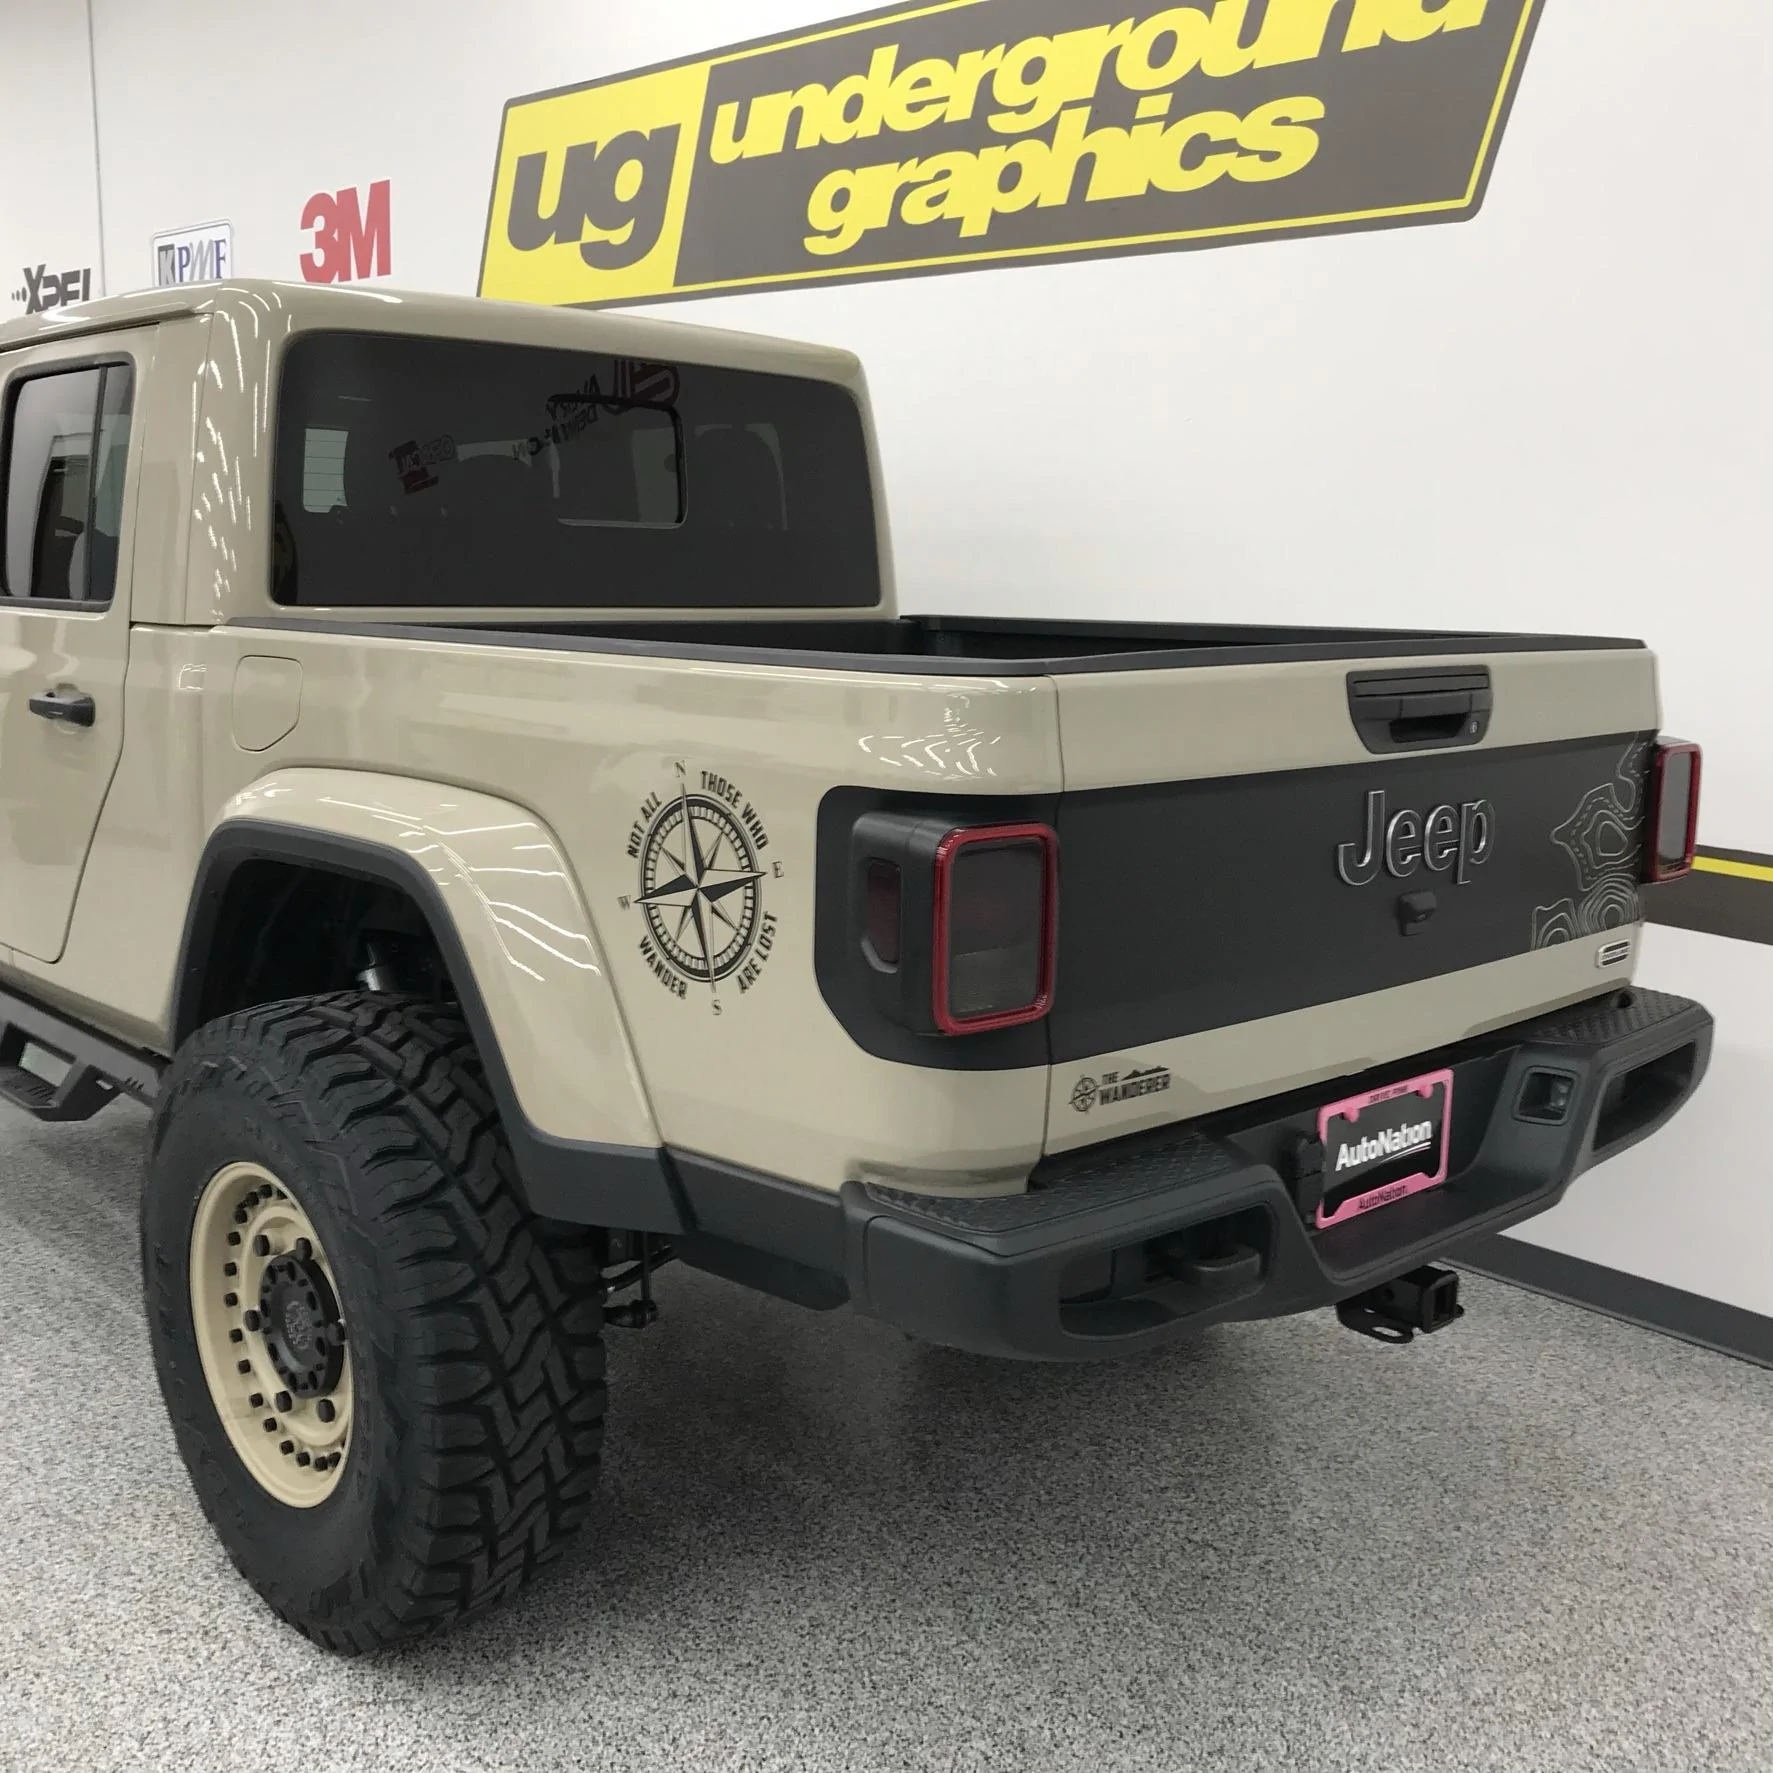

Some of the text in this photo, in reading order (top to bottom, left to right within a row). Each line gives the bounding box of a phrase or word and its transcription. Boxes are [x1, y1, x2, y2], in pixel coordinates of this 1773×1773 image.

[505, 121, 681, 271] ug
[804, 94, 1324, 254] graphics
[157, 238, 227, 286] KPMF
[301, 180, 391, 284] 3M
[626, 770, 769, 858] NOT ALL THOSE WHO
[1337, 789, 1497, 886] Jeep
[637, 910, 778, 1000] WANDER ARE LOST
[1099, 1073, 1171, 1106] WANDERER
[1101, 1070, 1120, 1085] THE
[1335, 1120, 1432, 1172] AutoNation
